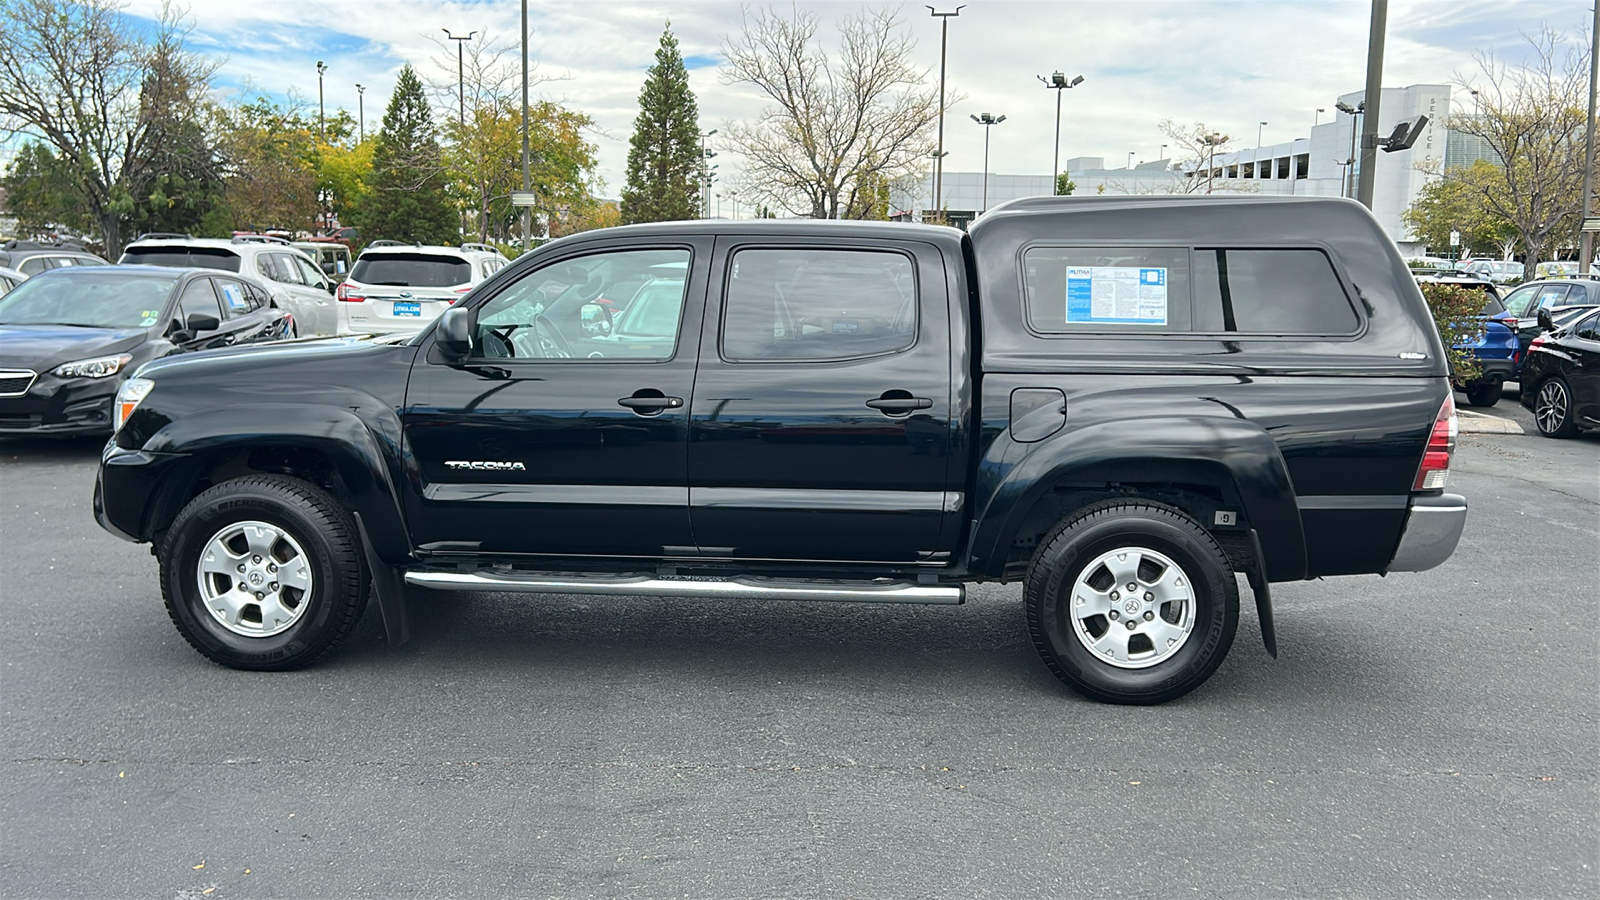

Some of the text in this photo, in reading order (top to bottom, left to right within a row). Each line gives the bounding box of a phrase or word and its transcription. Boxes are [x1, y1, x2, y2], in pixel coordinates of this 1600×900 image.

[1426, 98, 1436, 149] SERVICE
[444, 460, 526, 471] TACOMA
[1191, 609, 1224, 671] MICHELIN
